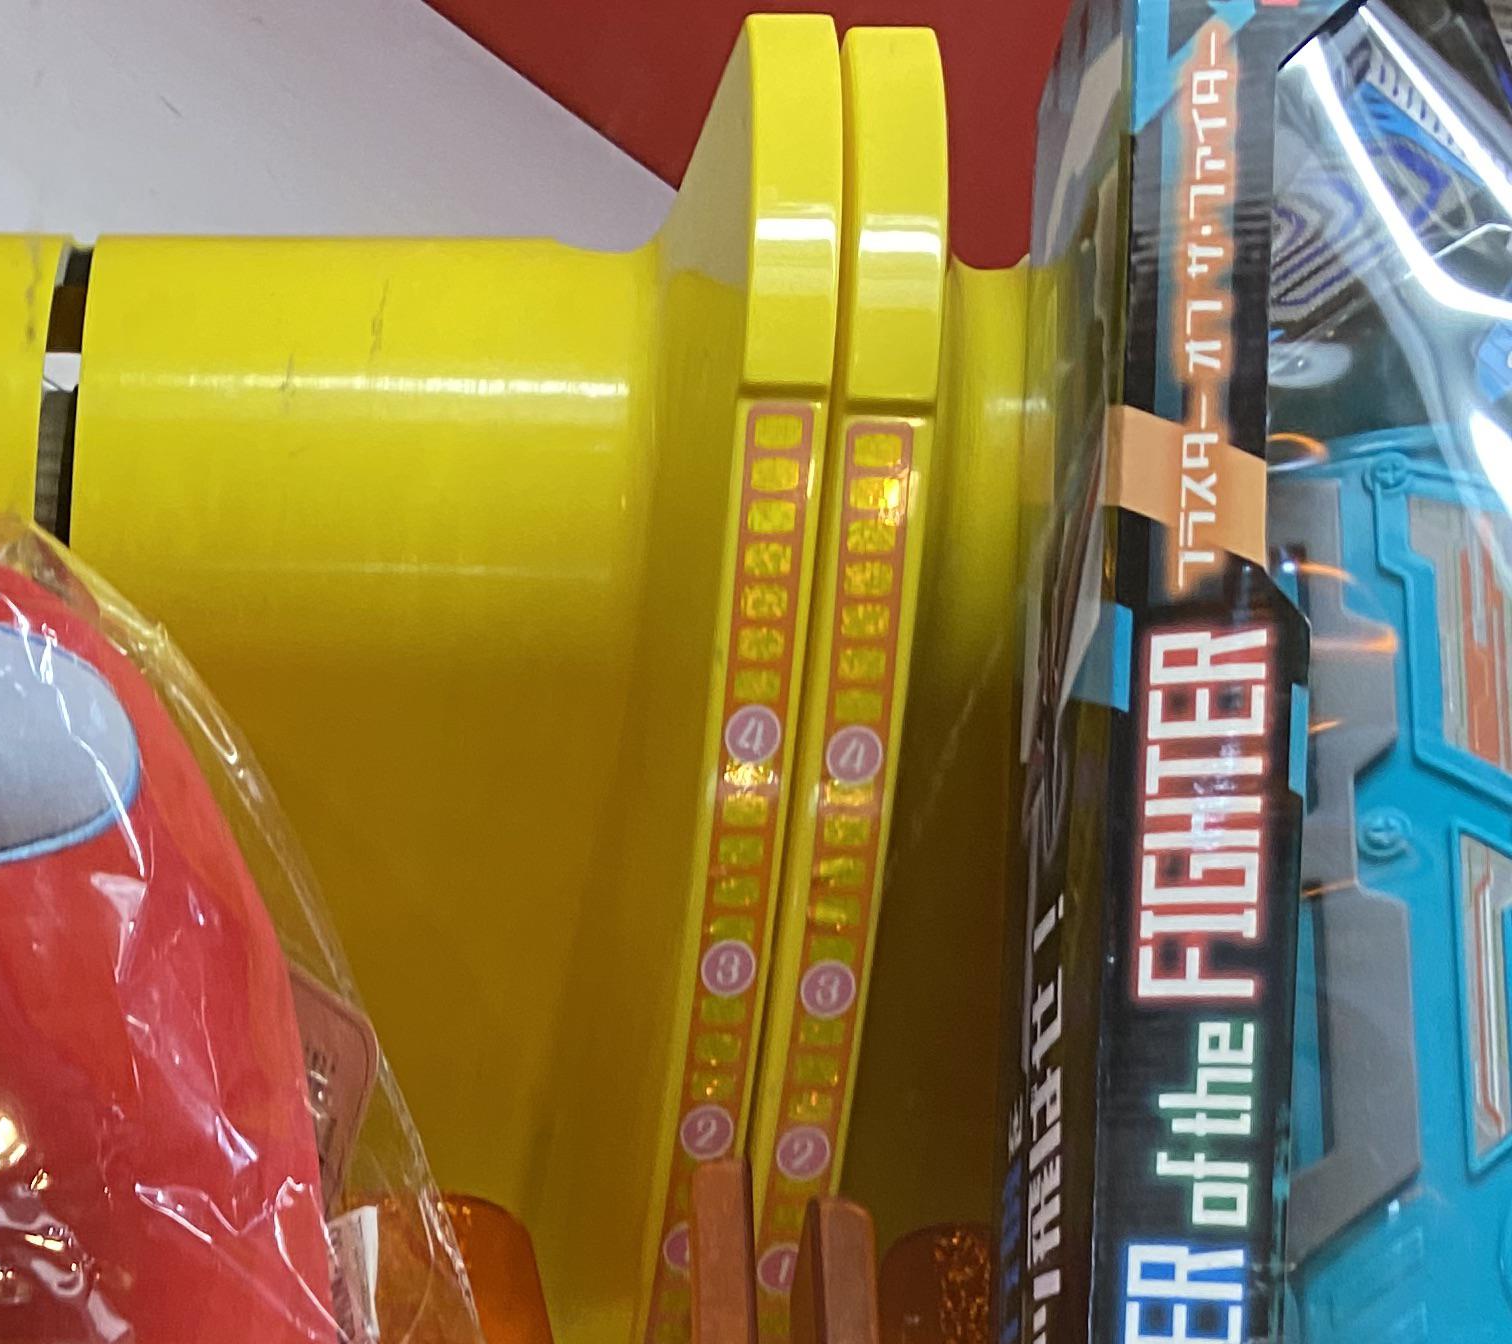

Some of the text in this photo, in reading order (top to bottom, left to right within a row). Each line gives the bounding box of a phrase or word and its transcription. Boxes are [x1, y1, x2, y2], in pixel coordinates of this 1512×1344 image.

[1137, 628, 1268, 999] FIGHTER
[1157, 1021, 1255, 1136] the
[1155, 1151, 1250, 1227] of
